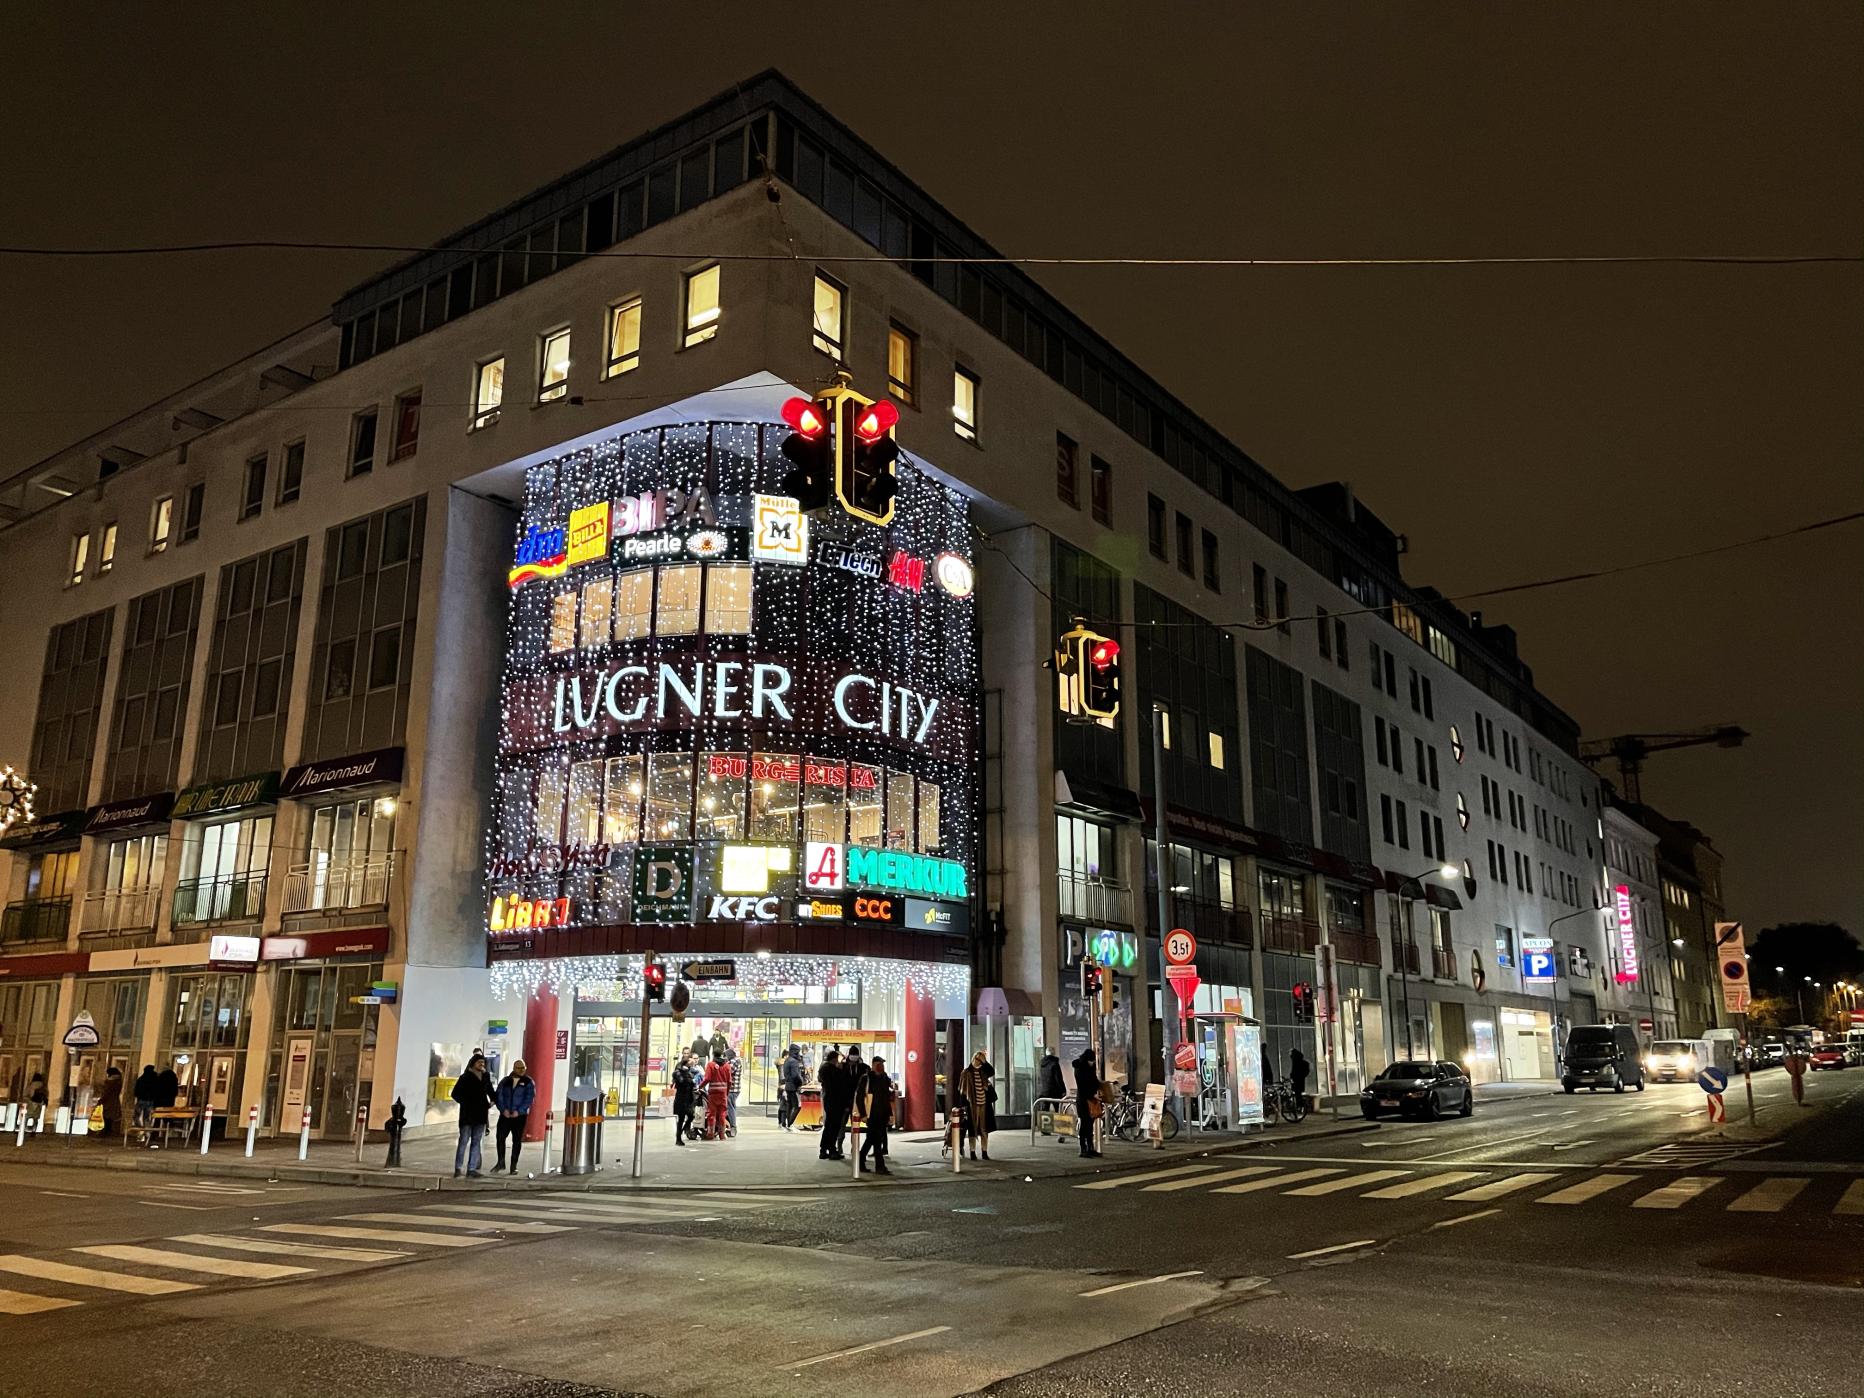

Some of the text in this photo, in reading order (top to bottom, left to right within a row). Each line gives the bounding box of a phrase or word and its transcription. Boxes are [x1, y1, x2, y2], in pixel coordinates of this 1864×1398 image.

[613, 487, 716, 536] BIPA
[760, 495, 798, 509] Mülle
[573, 520, 604, 544] BILLA
[770, 520, 792, 540] M
[517, 524, 564, 565] dm
[624, 536, 682, 559] Pearle
[553, 662, 940, 743] LUGNER CITY
[292, 756, 378, 792] Marionnaud
[88, 801, 152, 826] Marionnaud
[646, 861, 682, 899] D
[848, 847, 968, 897] MERKUR
[707, 896, 779, 920] KFC
[854, 898, 892, 919] CCC
[1620, 923, 1638, 975] LUGNER
[698, 964, 729, 975] EINBAHN
[1531, 955, 1549, 976] P
